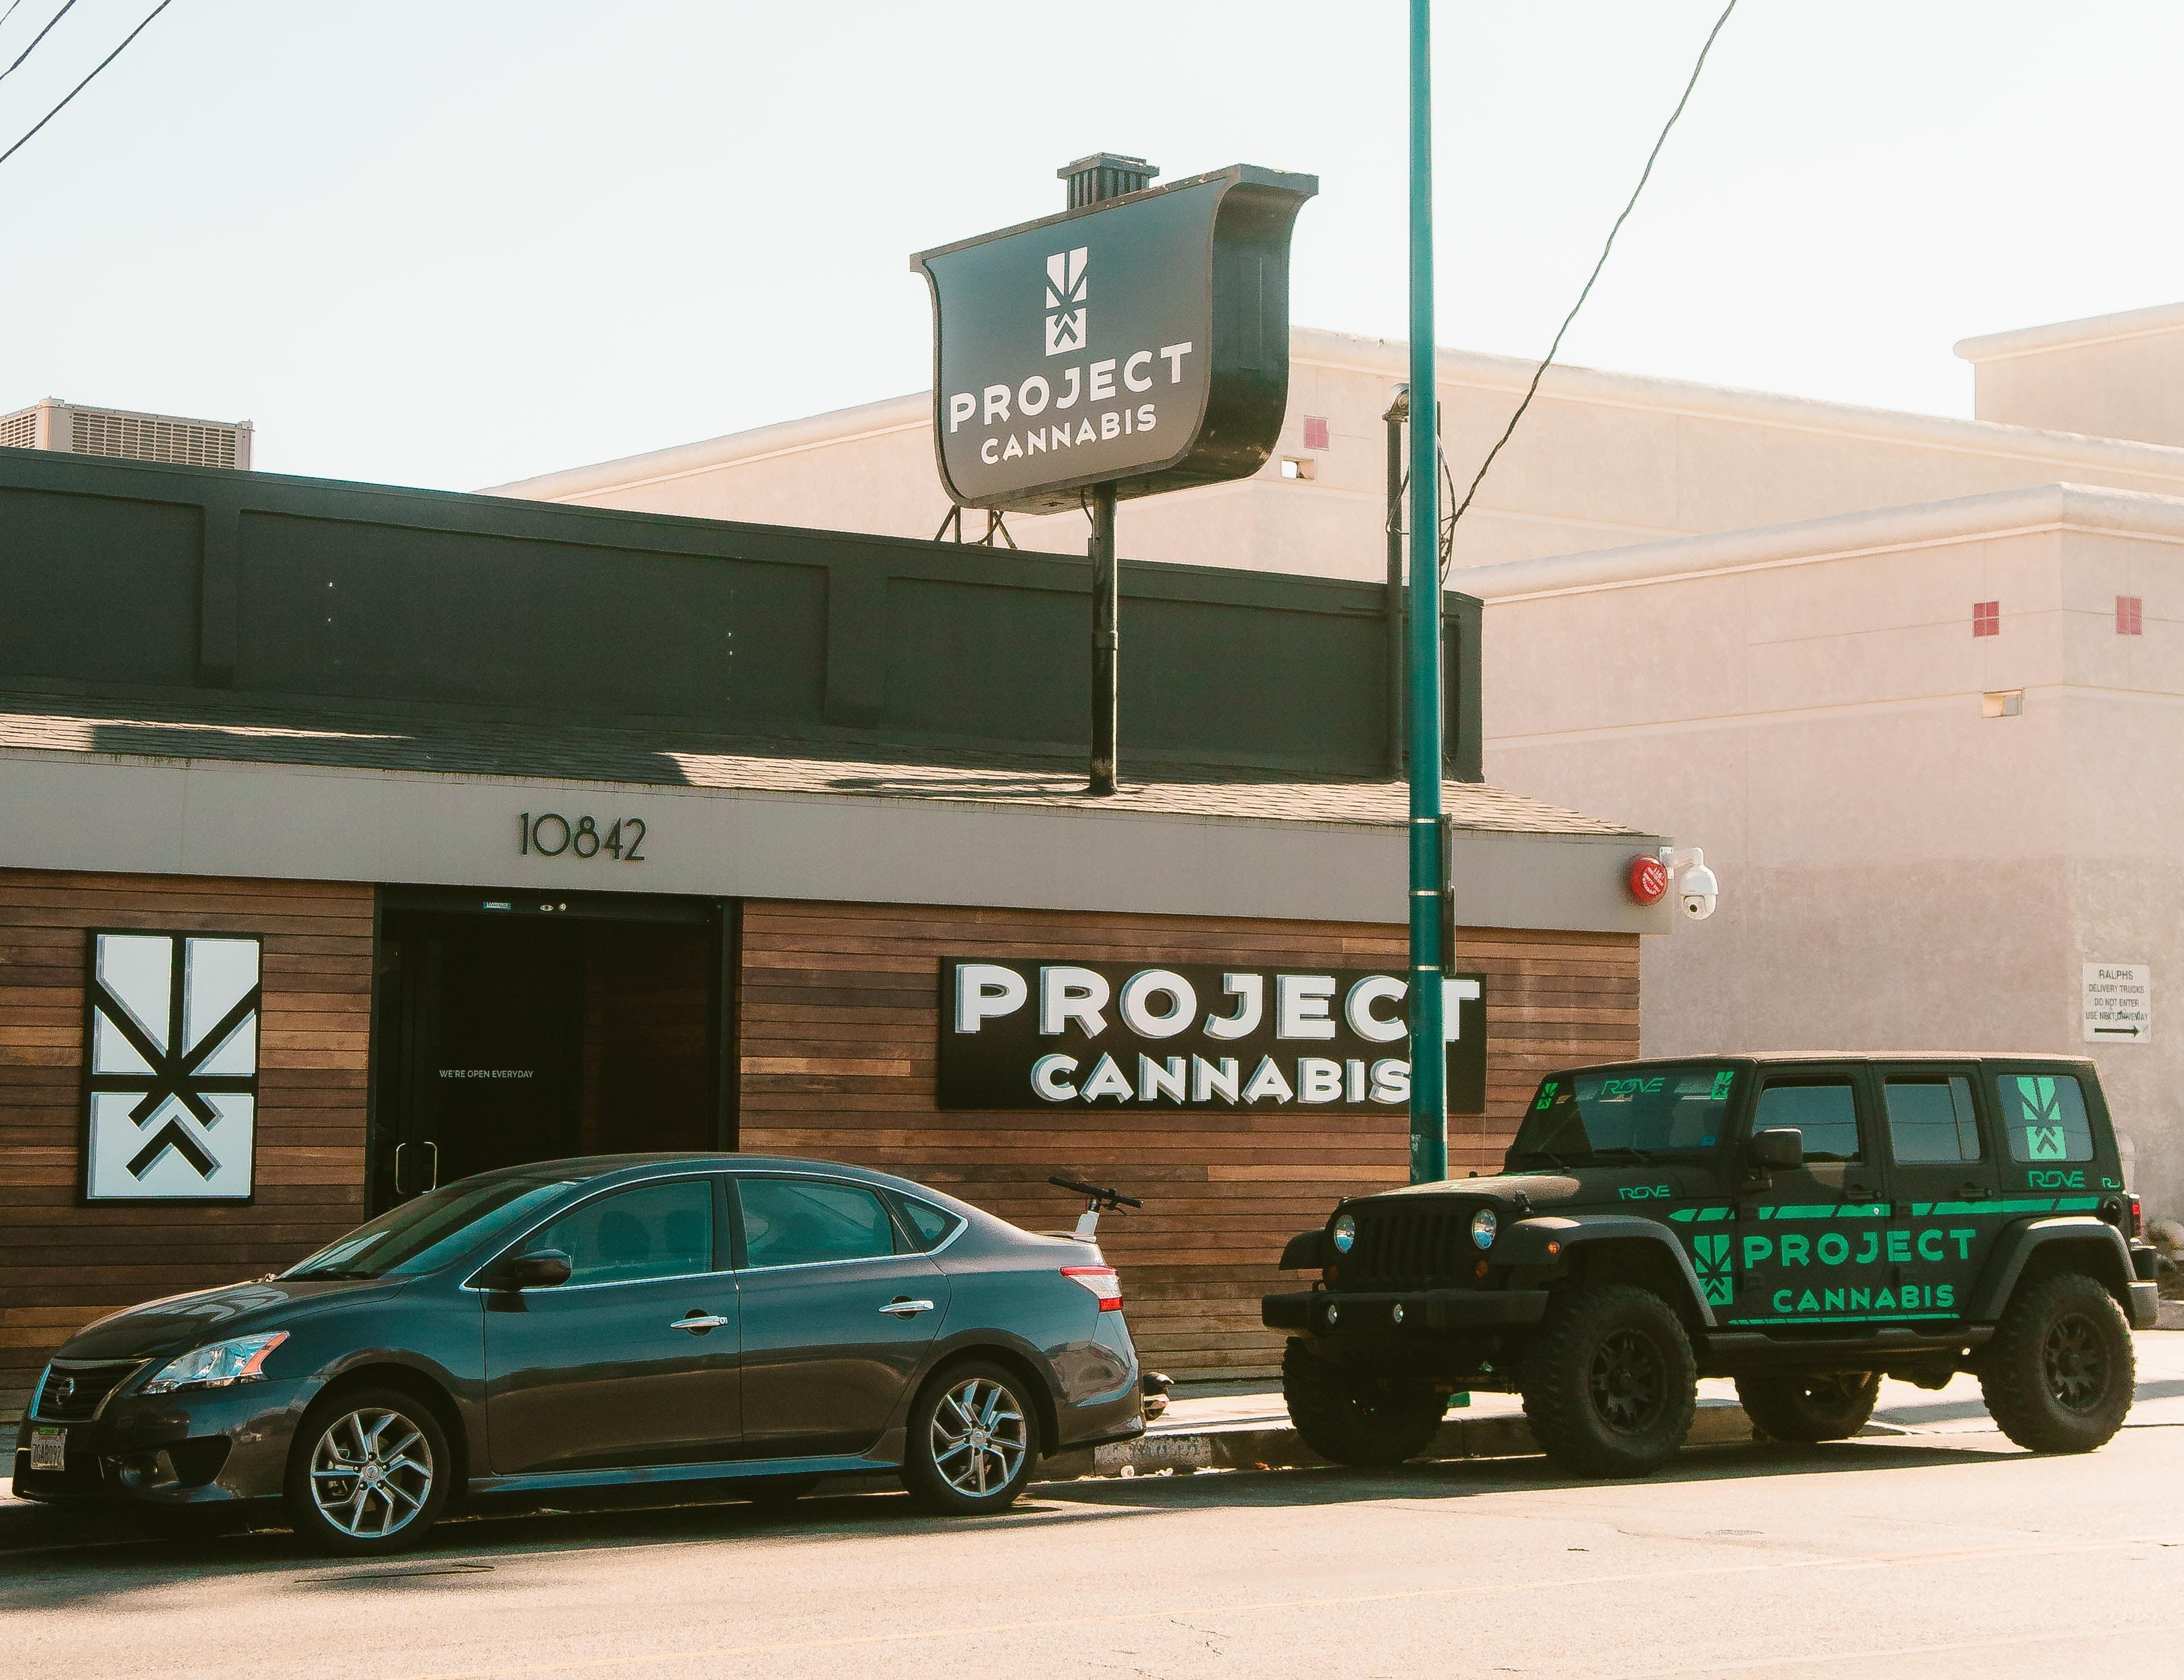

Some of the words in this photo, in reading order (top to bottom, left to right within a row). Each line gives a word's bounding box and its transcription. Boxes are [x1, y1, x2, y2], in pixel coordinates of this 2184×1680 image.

[950, 341, 1192, 434] PROJECT
[981, 404, 1157, 465] CANNABIS
[520, 812, 647, 861] 10842
[2099, 969, 2134, 980] RALPHS
[2088, 984, 2119, 994] DELIVERY
[2120, 984, 2145, 994] TRUCKS
[955, 964, 1480, 1042] PROJECT
[2094, 998, 2104, 1007] DO
[2105, 998, 2118, 1007] NOT
[2119, 998, 2140, 1007] ENTER
[2086, 1011, 2098, 1020] USE
[2099, 1011, 2115, 1020] NEXT
[2117, 1012, 2149, 1021] DRIVEWAY
[439, 1069, 466, 1078] WE'RE
[467, 1069, 490, 1078] OPEN
[492, 1070, 534, 1078] EVERYDAY
[1030, 1051, 1411, 1105] CANNABIS
[1601, 1077, 1665, 1095] ROVE
[2027, 1170, 2086, 1189] ROVE
[1618, 1185, 1671, 1201] ROVE
[1743, 1228, 1976, 1269] PROJECT
[1772, 1284, 1955, 1313] CANNABIS
